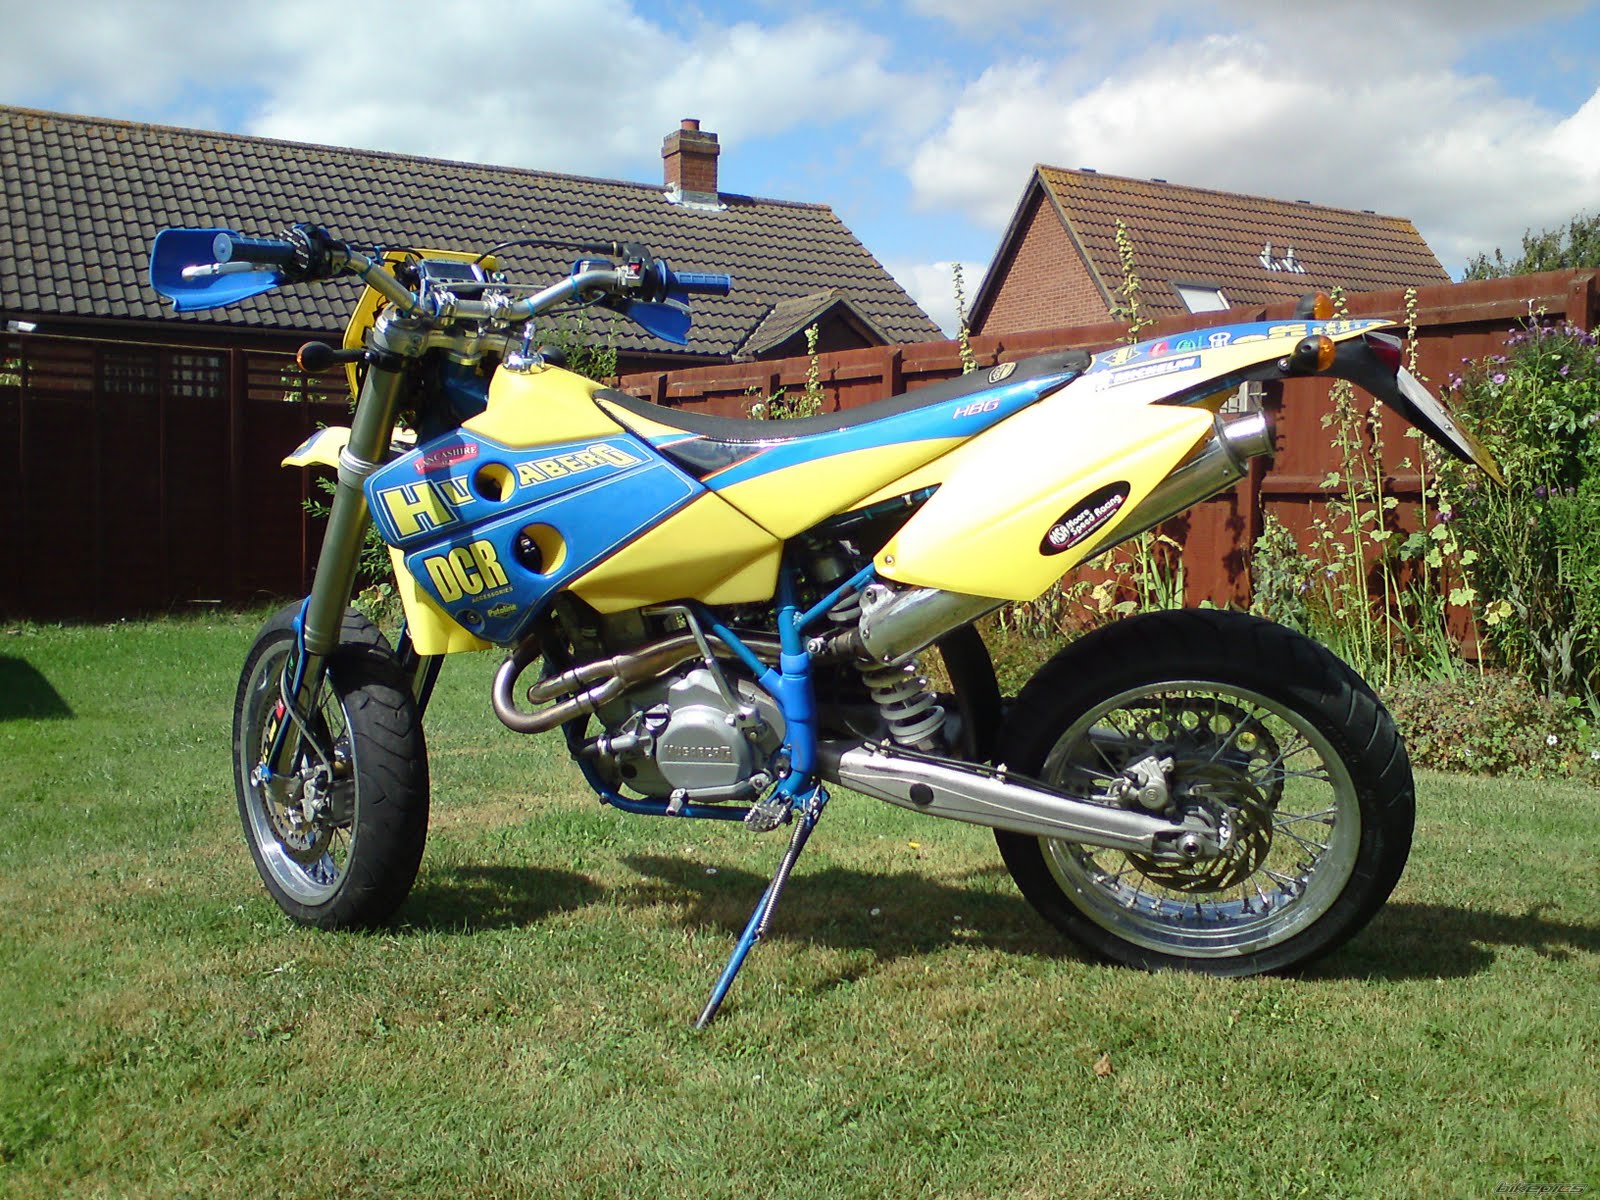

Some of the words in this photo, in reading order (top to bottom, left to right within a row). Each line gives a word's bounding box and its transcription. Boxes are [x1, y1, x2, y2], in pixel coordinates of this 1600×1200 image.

[415, 446, 477, 471] LANCASHIRE
[378, 443, 641, 540] HUABERG
[1065, 509, 1090, 530] Moore
[1070, 513, 1095, 536] Speed
[1093, 494, 1123, 517] Racing
[424, 540, 510, 602] DCR
[471, 586, 514, 604] ACCESSORIES
